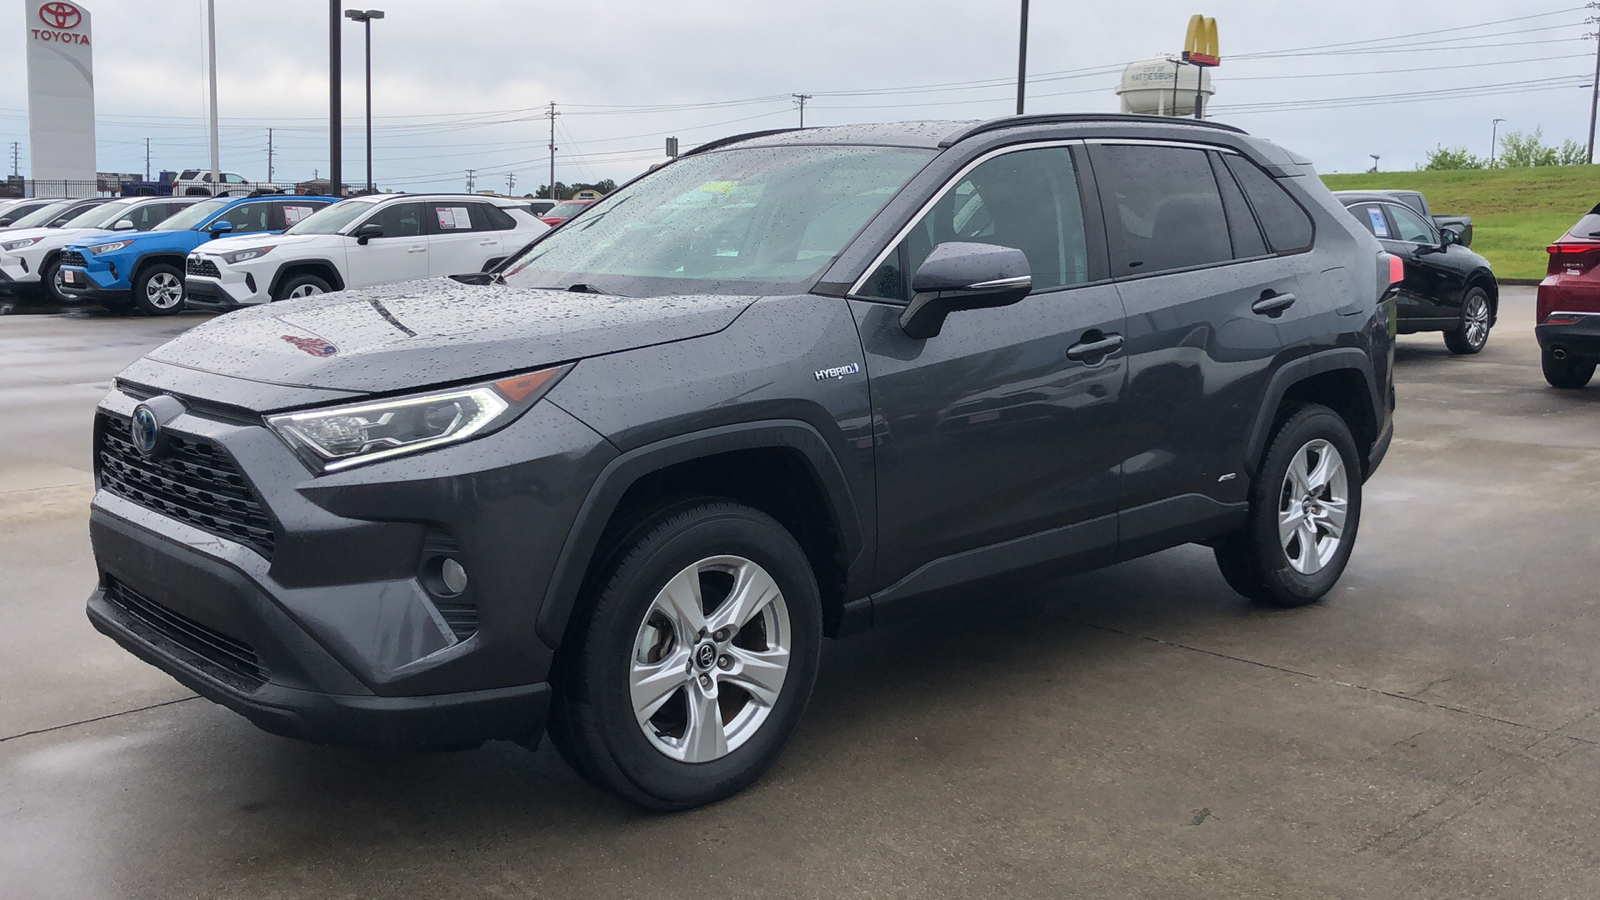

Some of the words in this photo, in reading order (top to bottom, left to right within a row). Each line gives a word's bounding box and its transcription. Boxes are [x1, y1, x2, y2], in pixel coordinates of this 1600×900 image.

[31, 29, 90, 45] TOYOTA
[1131, 72, 1177, 81] HATTIESBUR
[814, 365, 852, 380] HYBRID
